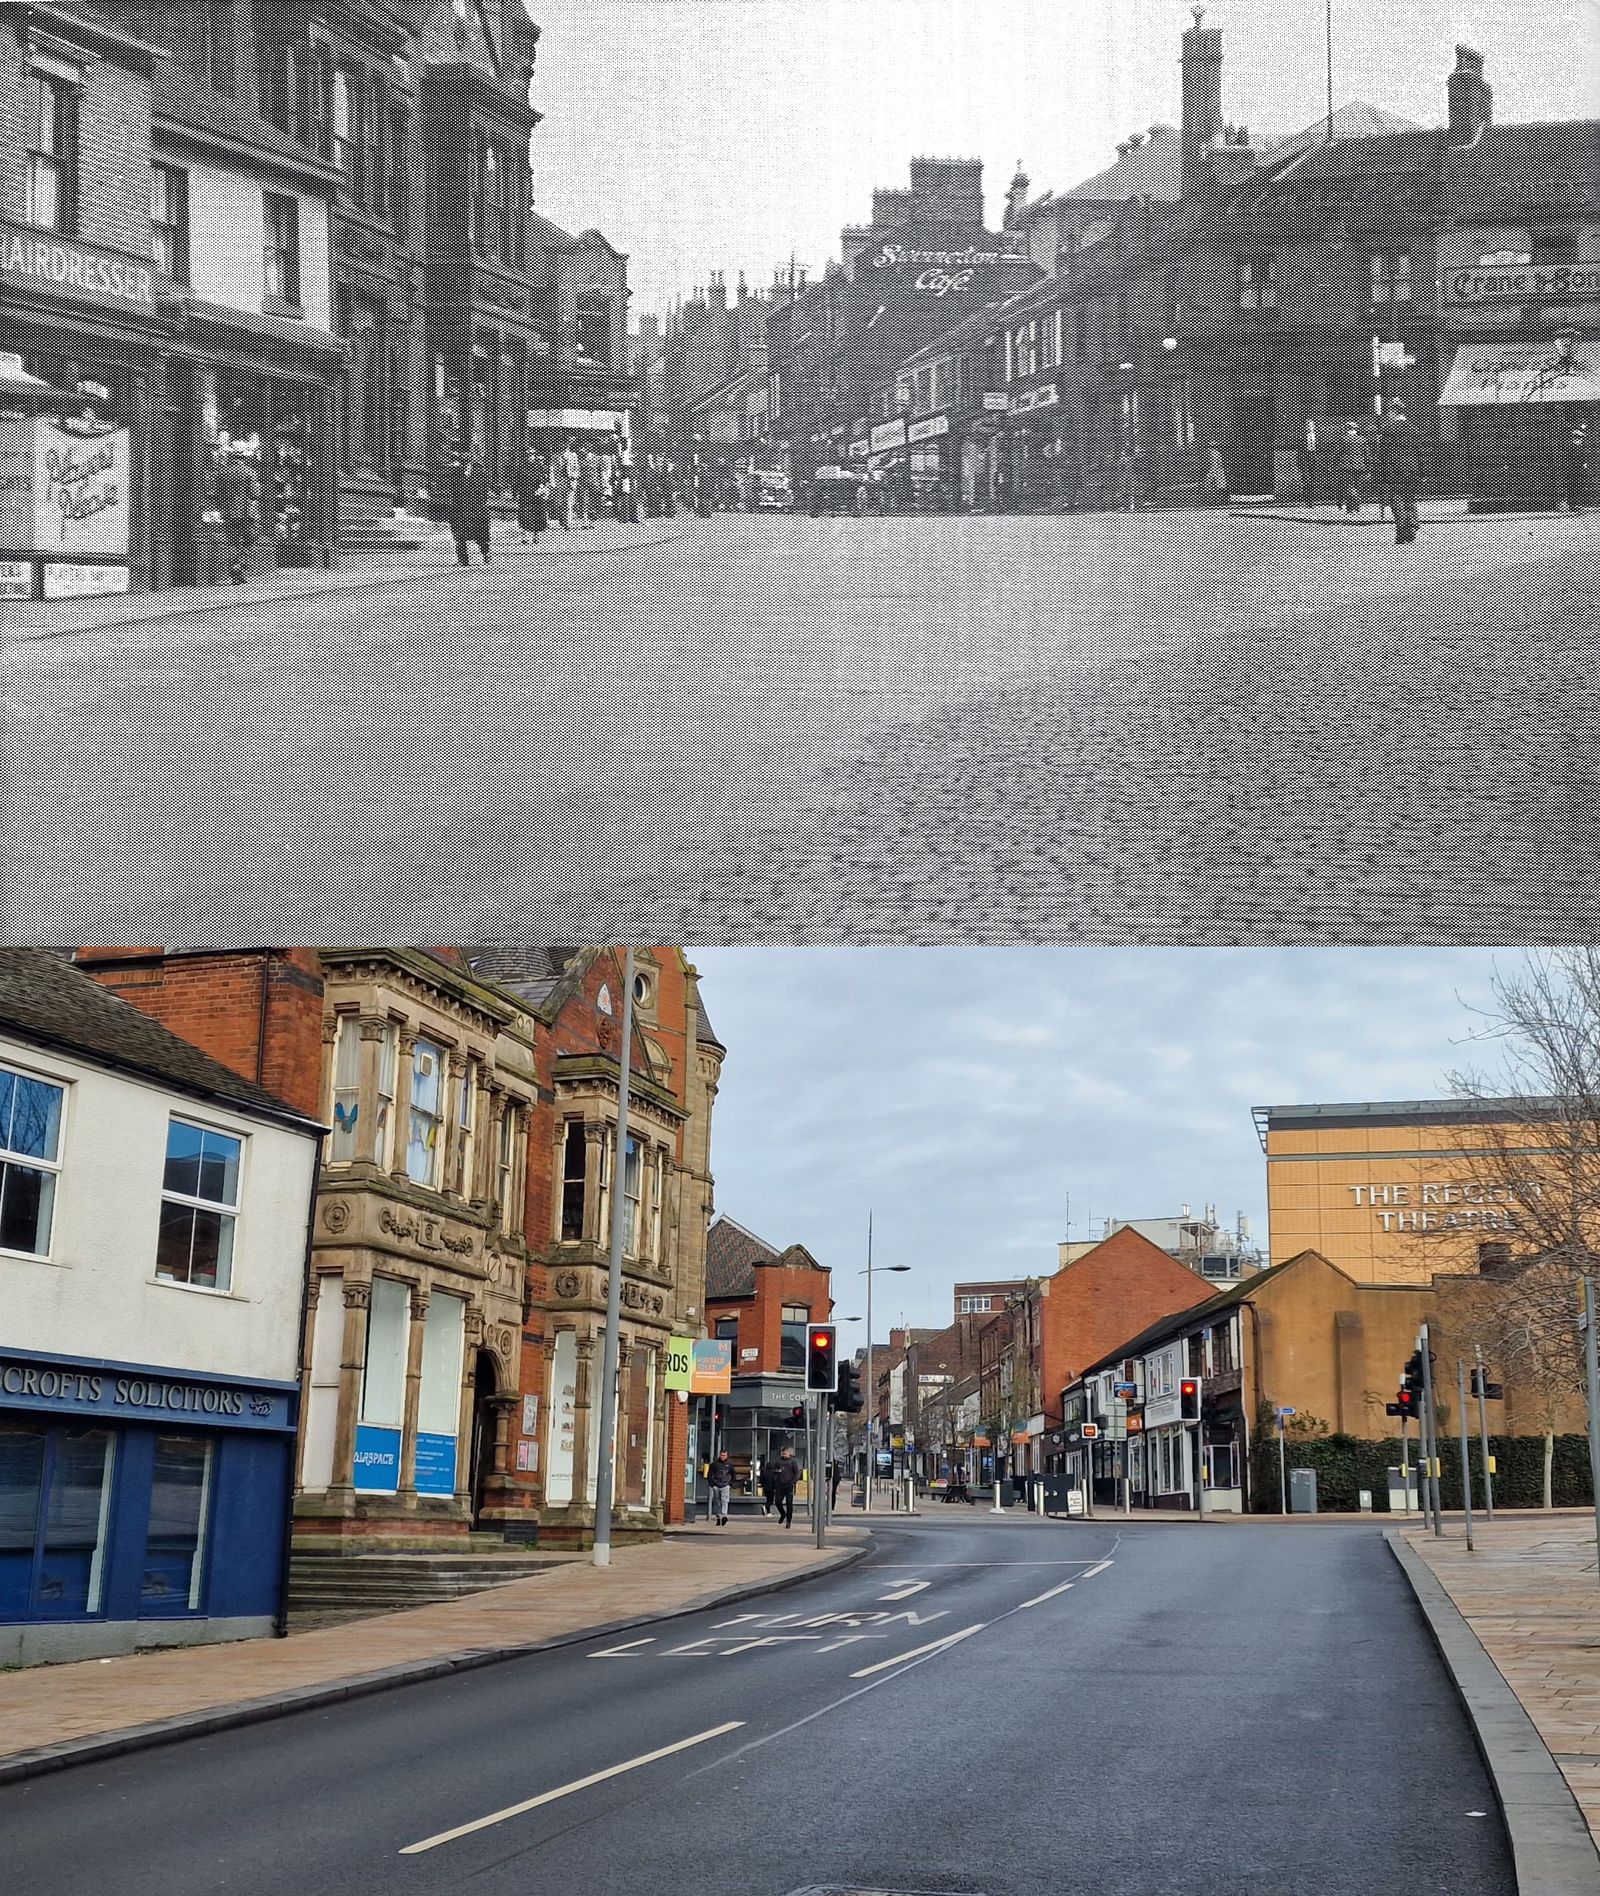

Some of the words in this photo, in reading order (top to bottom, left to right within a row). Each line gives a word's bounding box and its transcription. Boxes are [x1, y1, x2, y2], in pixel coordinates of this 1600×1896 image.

[1453, 271, 1526, 298] Crane
[1350, 1184, 1410, 1206] THE
[1422, 1181, 1544, 1205] REGE
[0, 1366, 103, 1402] CROFTS
[115, 1378, 245, 1416] SOLICITORS
[771, 1392, 787, 1401] THE
[708, 1610, 952, 1629] TURN
[585, 1634, 889, 1658] LEFT
